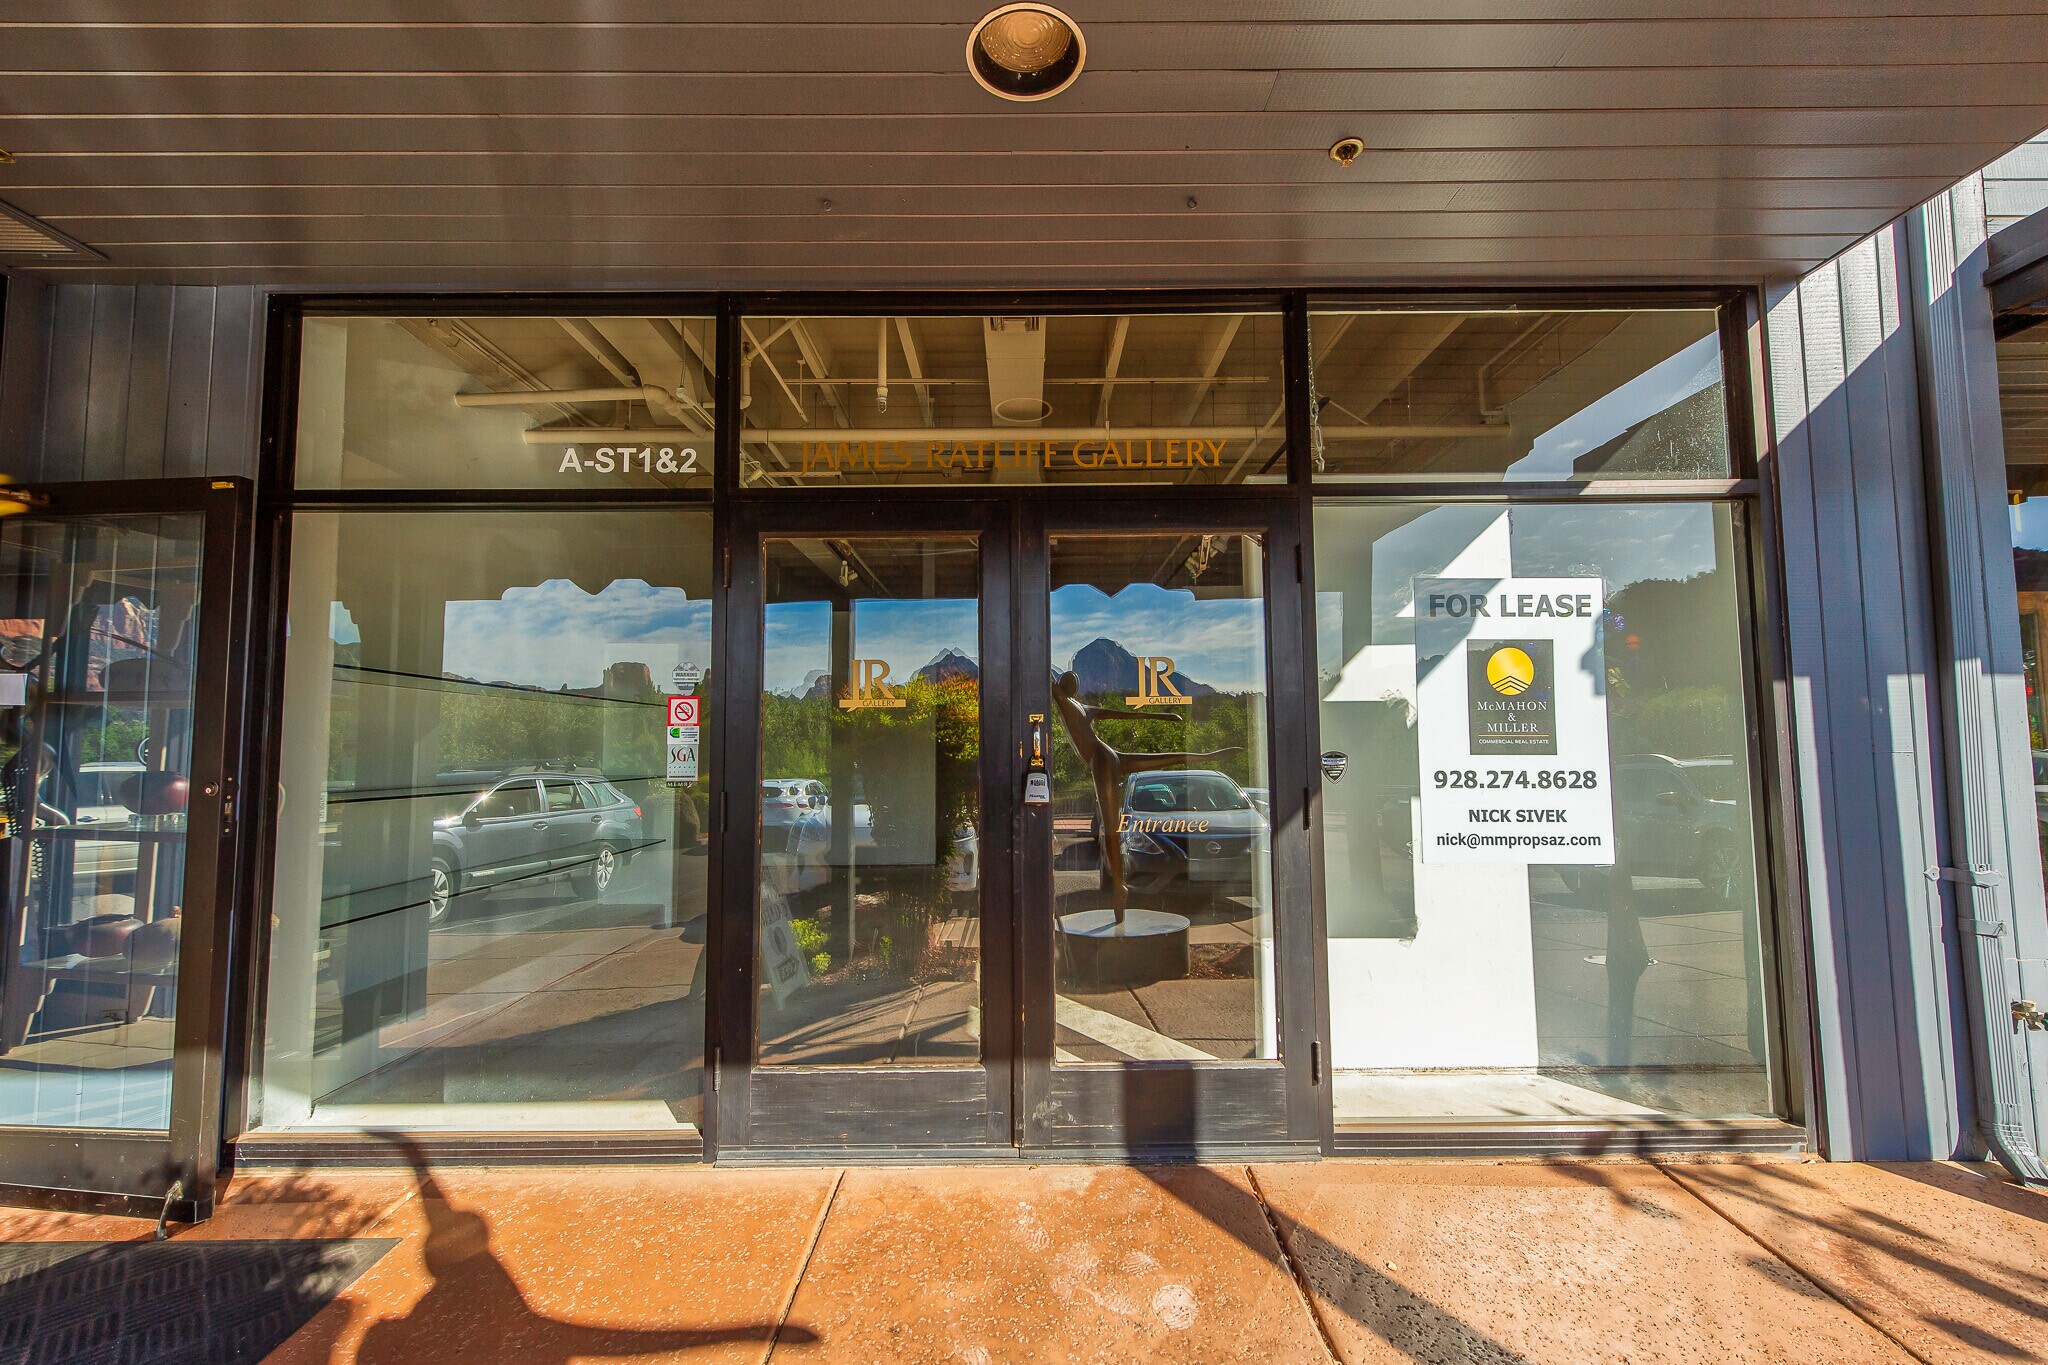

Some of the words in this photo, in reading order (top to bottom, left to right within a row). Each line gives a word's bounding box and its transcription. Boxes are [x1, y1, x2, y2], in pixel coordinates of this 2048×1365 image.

[558, 447, 697, 474] A-ST1&2
[800, 441, 912, 476] JAMES
[926, 440, 1059, 469] RATLIFF
[1072, 438, 1227, 467] GALLERY
[1429, 594, 1491, 618] FOR
[1500, 594, 1592, 618] LEASE
[847, 659, 896, 713] JR
[1133, 656, 1183, 710] JR
[1477, 701, 1547, 711] McMAHON
[1507, 712, 1517, 722] &
[1487, 722, 1539, 733] MILLER
[669, 746, 696, 765] SGA
[1433, 770, 1598, 790] 928.274.8628
[1116, 813, 1210, 833] Entrance
[1469, 809, 1512, 823] NICK
[1515, 809, 1568, 823] SIVEK
[1436, 832, 1602, 850] nick@mmpropsaz.com
